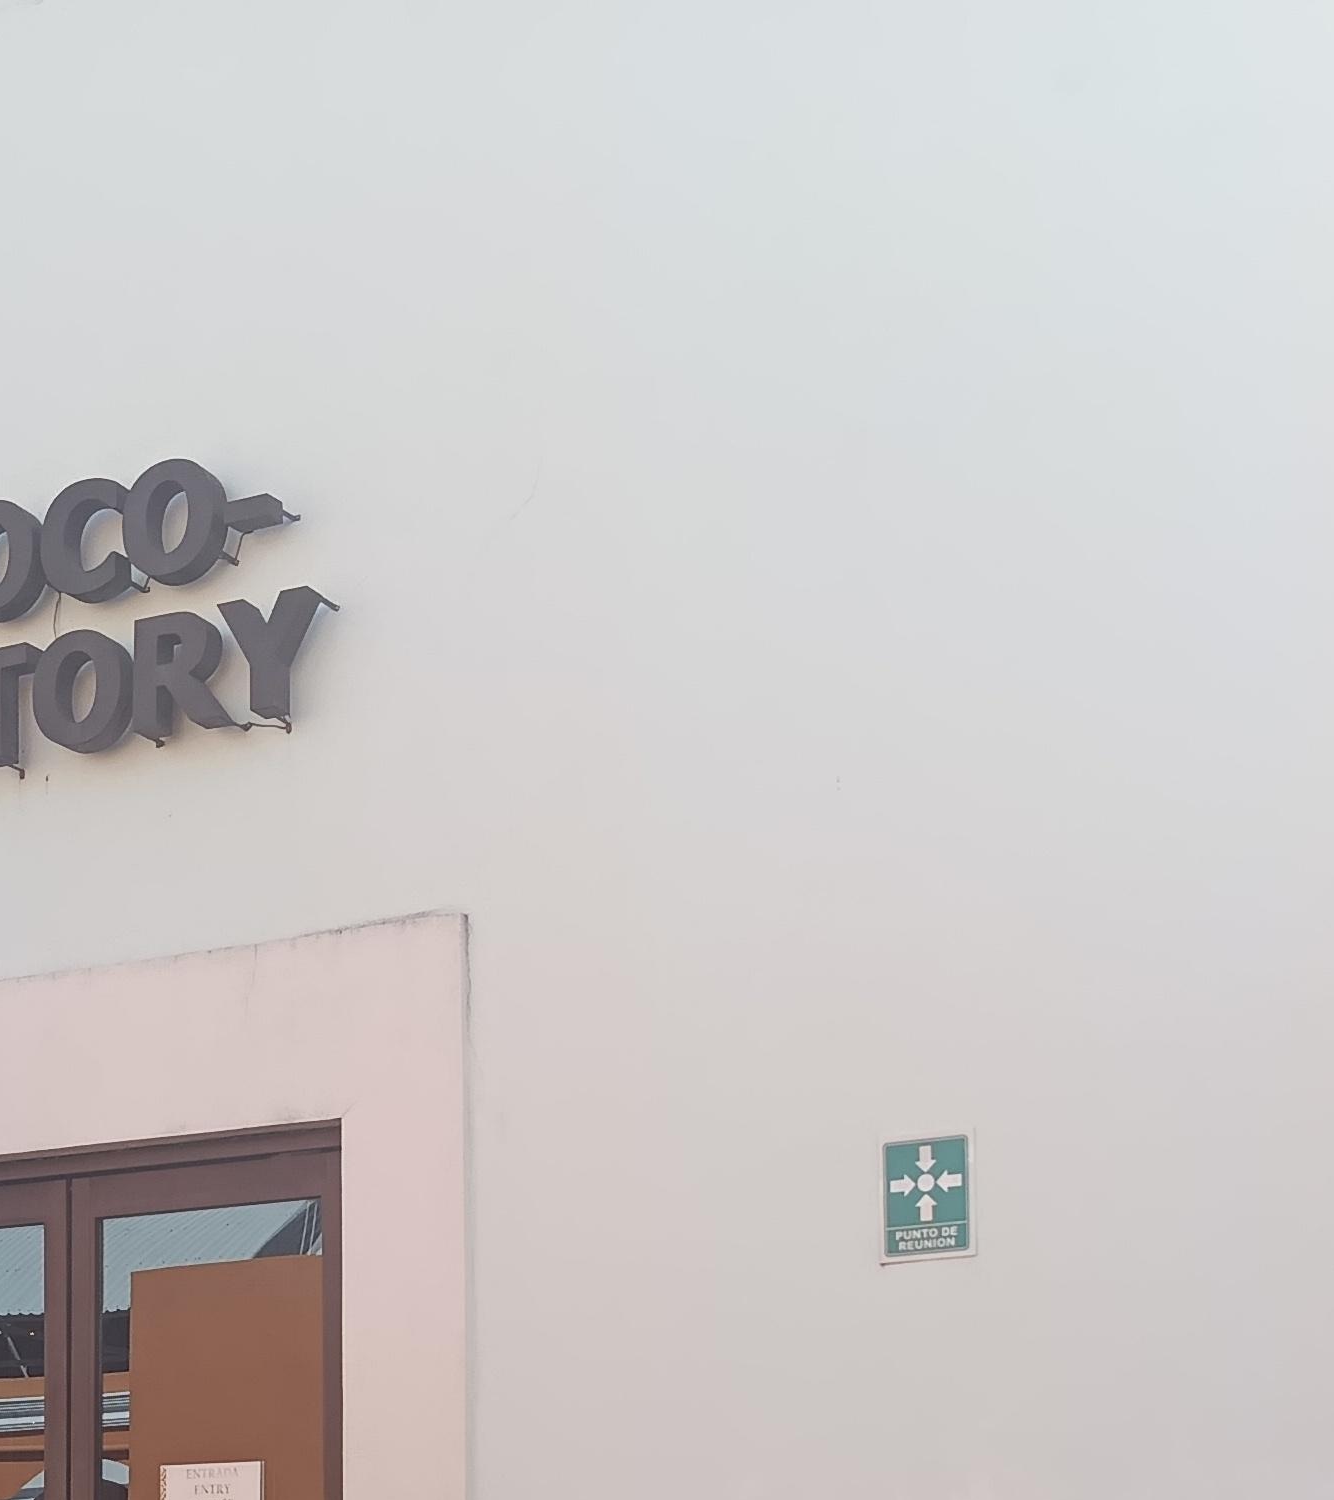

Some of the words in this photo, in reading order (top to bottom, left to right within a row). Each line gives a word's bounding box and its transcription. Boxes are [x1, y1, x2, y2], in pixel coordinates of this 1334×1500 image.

[895, 1227, 938, 1241] PUNTO
[941, 1226, 958, 1237] DE
[194, 1483, 232, 1495] ENTRY
